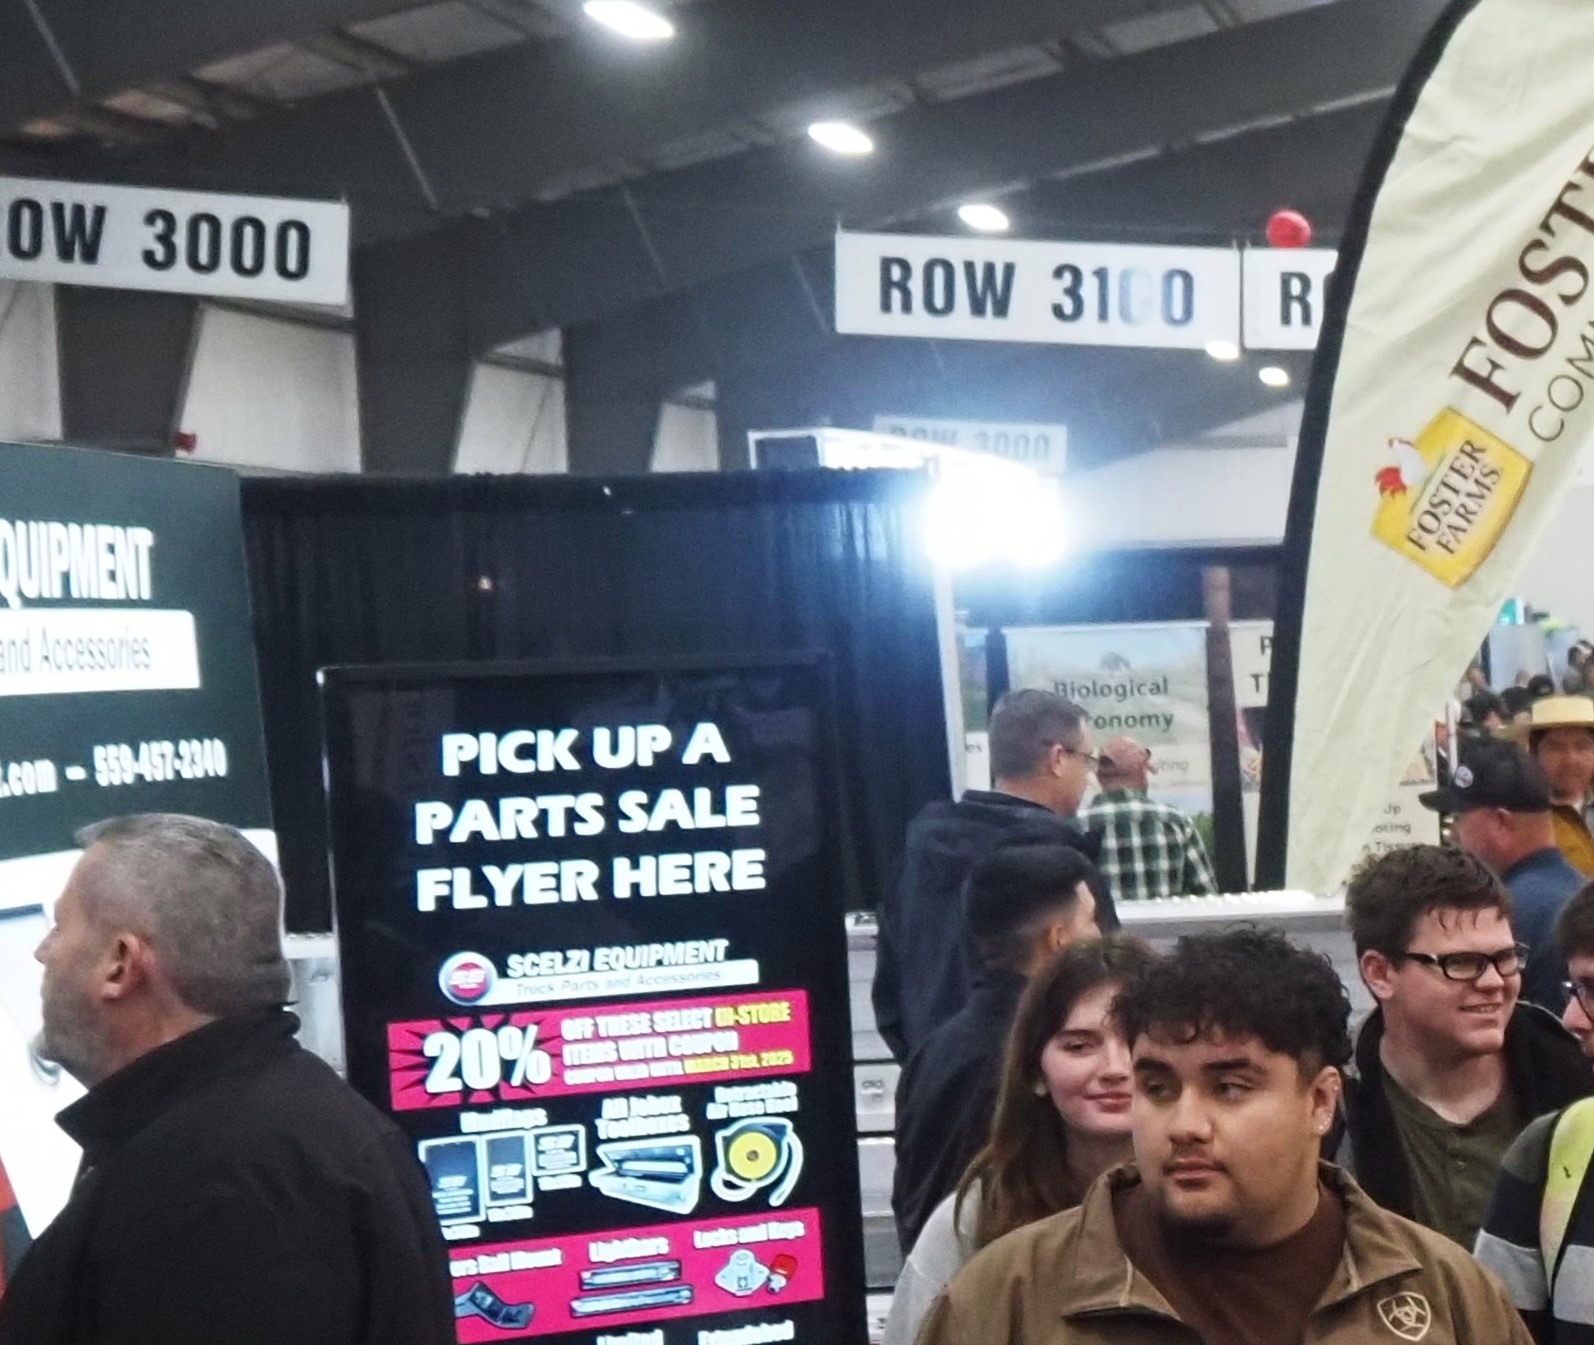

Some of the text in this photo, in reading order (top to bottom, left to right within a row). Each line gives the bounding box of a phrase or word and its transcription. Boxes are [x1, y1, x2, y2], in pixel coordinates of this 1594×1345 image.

[143, 210, 310, 281] 3000
[879, 257, 1195, 327] ROW 3100
[1406, 439, 1489, 553] FOSTER
[1437, 464, 1502, 557] FARMS
[40, 626, 151, 672] Accessories
[1054, 677, 1169, 703] Biological
[1088, 711, 1175, 733] ronomy
[93, 738, 228, 788] 559-457-2340
[442, 722, 731, 776] PICK UP A
[415, 785, 761, 845] PARTS SALE
[416, 849, 766, 912] FLYER HERE
[507, 949, 592, 979] SCELZI
[592, 939, 730, 972] EQUIPMENT
[516, 969, 721, 998] Truck Parts and Accessories
[561, 1001, 791, 1041] OFF THESE SELECT IN-STORE
[668, 1030, 739, 1056] COUPON
[423, 1023, 553, 1094] 20%
